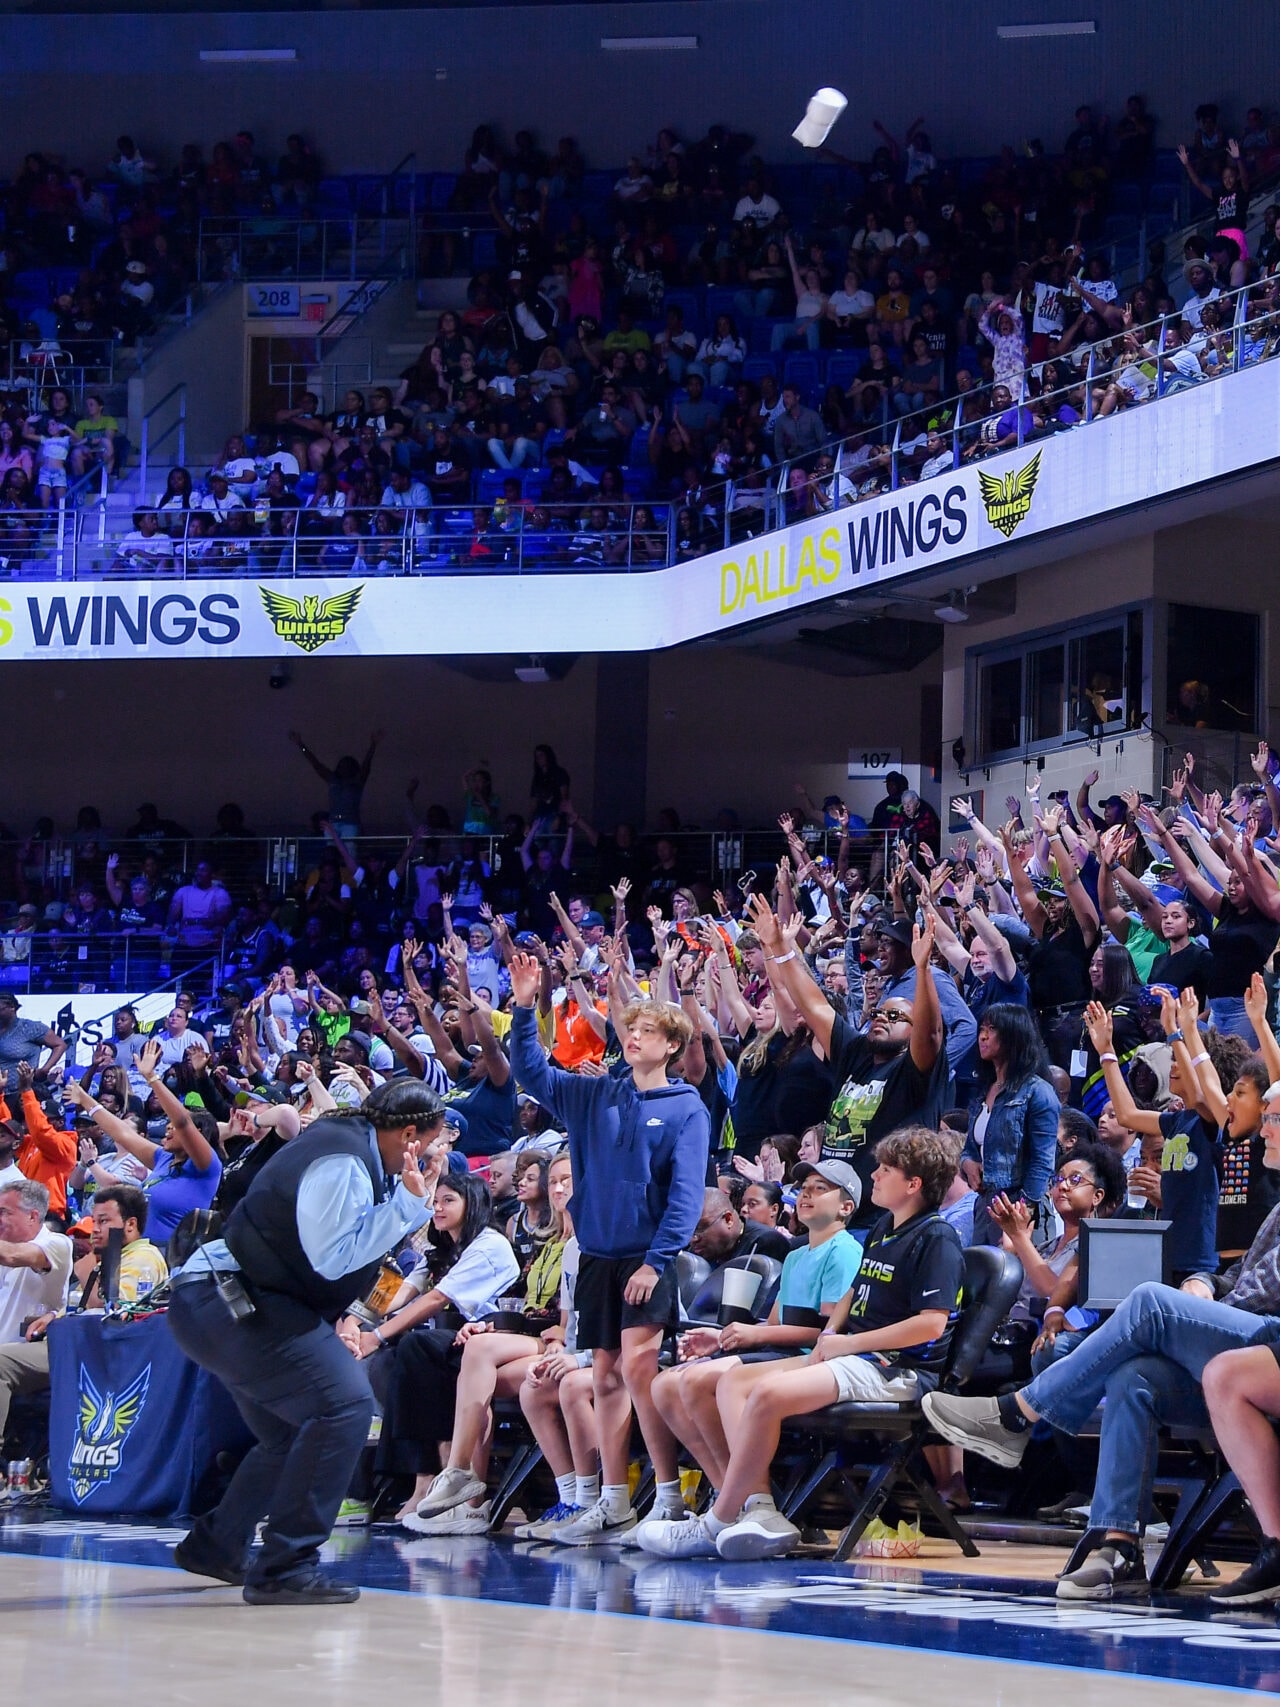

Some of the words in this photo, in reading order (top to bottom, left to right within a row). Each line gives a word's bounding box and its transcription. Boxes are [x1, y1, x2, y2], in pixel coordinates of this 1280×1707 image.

[258, 290, 290, 306] 208
[720, 527, 842, 616] DALLAS
[847, 485, 968, 575] WINGS
[26, 593, 241, 646] WINGS
[860, 752, 891, 769] 107
[860, 1257, 895, 1283] EXAS
